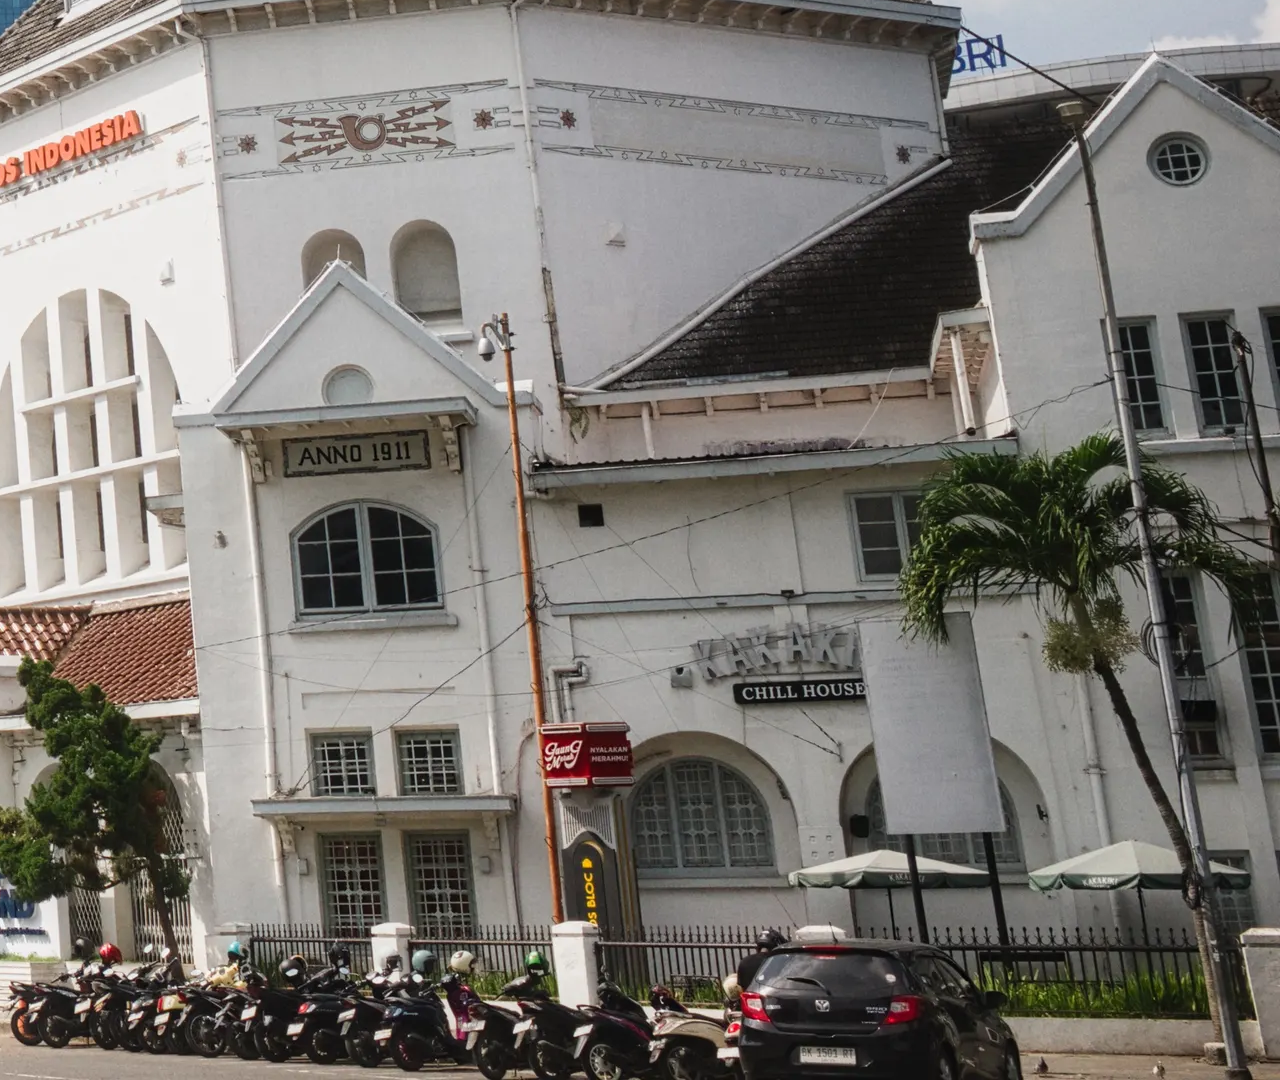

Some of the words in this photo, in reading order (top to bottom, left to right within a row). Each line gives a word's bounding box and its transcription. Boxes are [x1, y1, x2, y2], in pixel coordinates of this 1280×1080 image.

[23, 110, 144, 177] INDONESIA
[298, 444, 362, 466] ANNO
[372, 441, 411, 461] 1911
[742, 685, 798, 701] CHILL
[803, 682, 865, 698] HOUSE
[583, 873, 596, 908] BLOC
[801, 1047, 812, 1057] BK
[842, 1049, 854, 1059] RT
